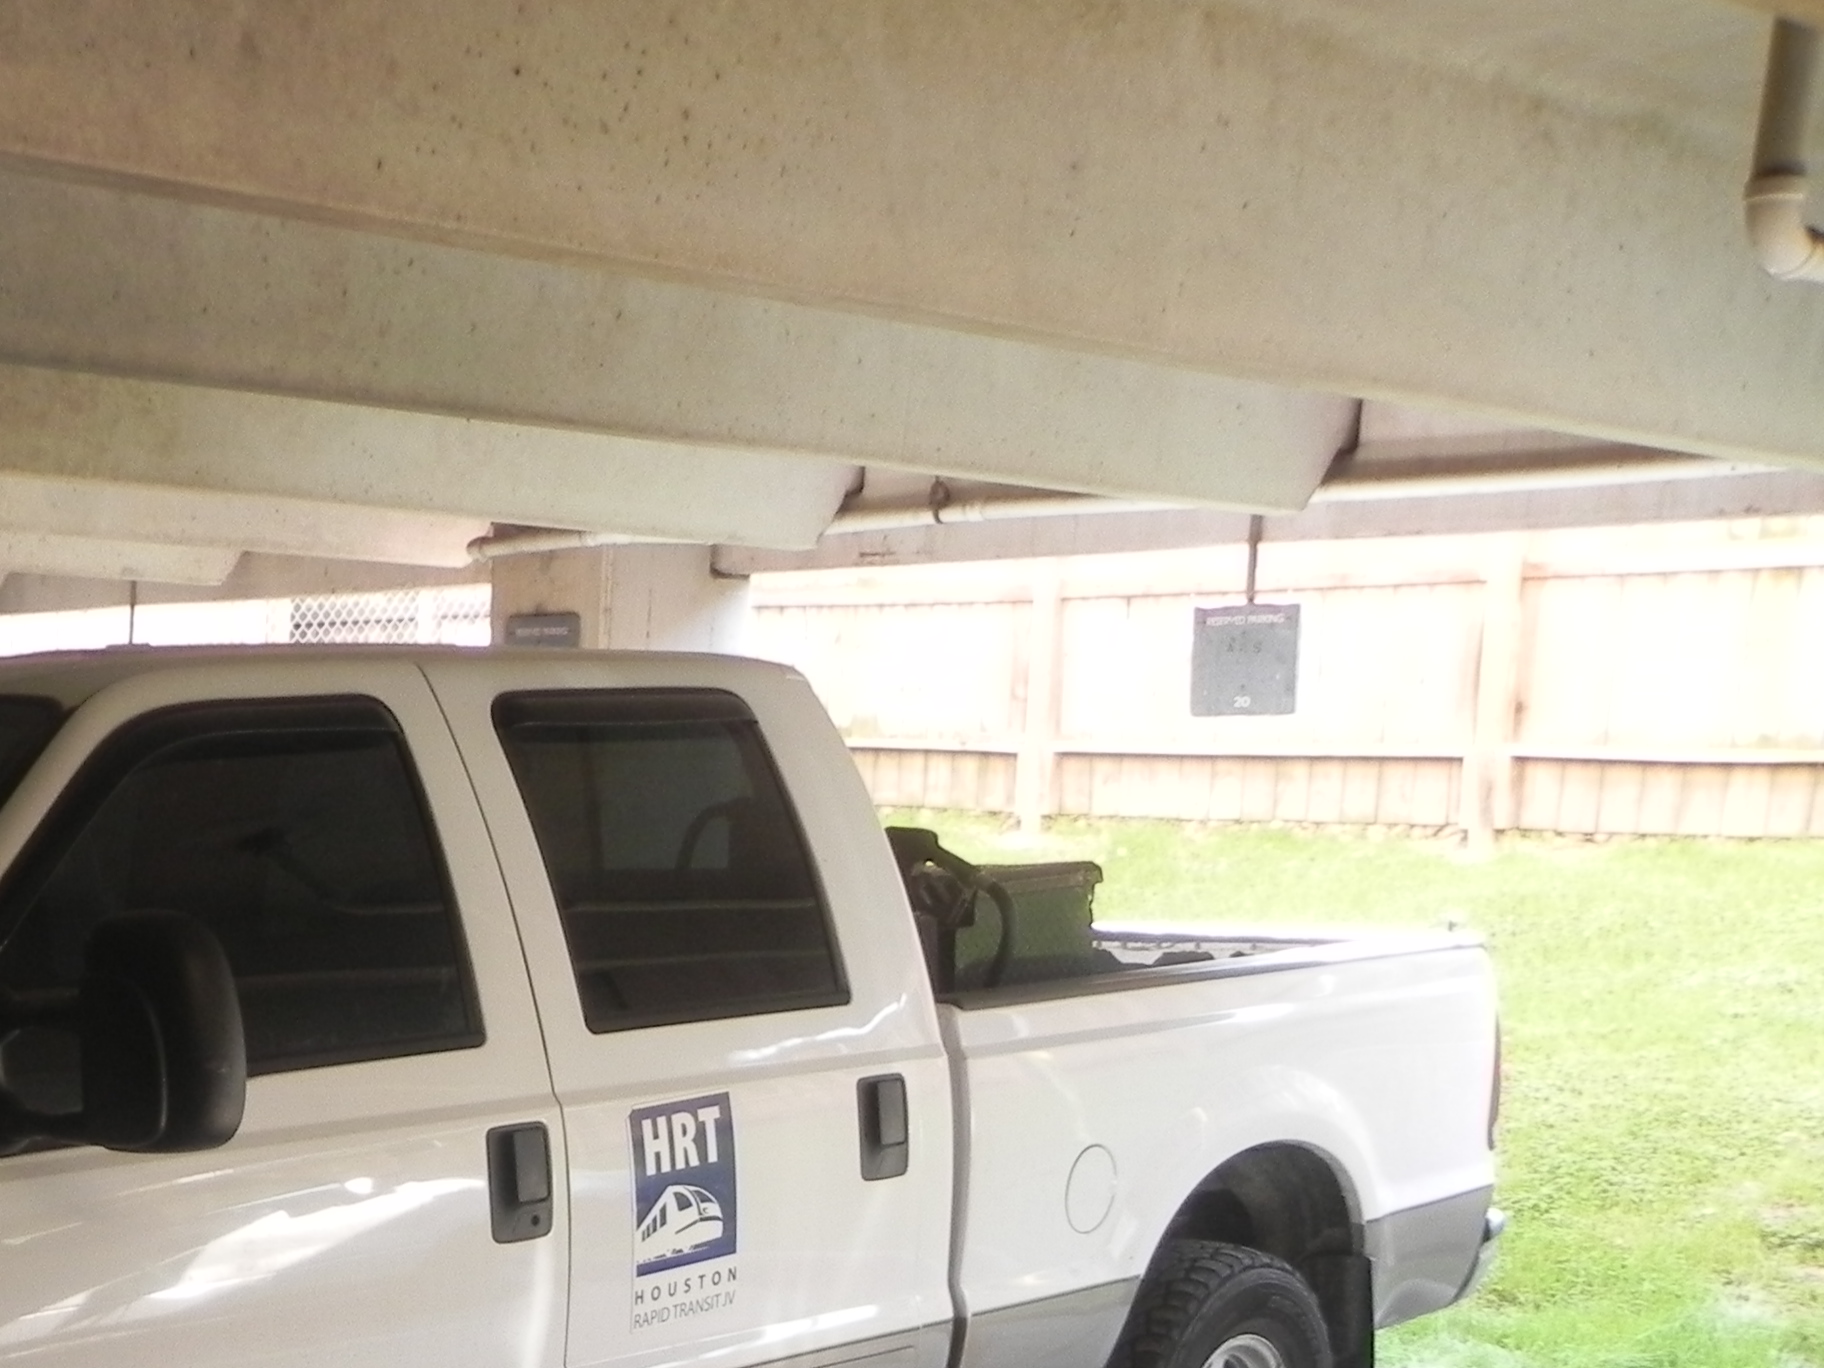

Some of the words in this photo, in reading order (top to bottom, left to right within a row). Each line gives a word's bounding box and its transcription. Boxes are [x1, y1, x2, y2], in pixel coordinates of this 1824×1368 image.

[1234, 696, 1251, 708] 20
[641, 1105, 721, 1177] HRT
[635, 1267, 737, 1306] HOUSTON
[633, 1307, 671, 1329] RAPID
[671, 1293, 722, 1319] TRANSIT
